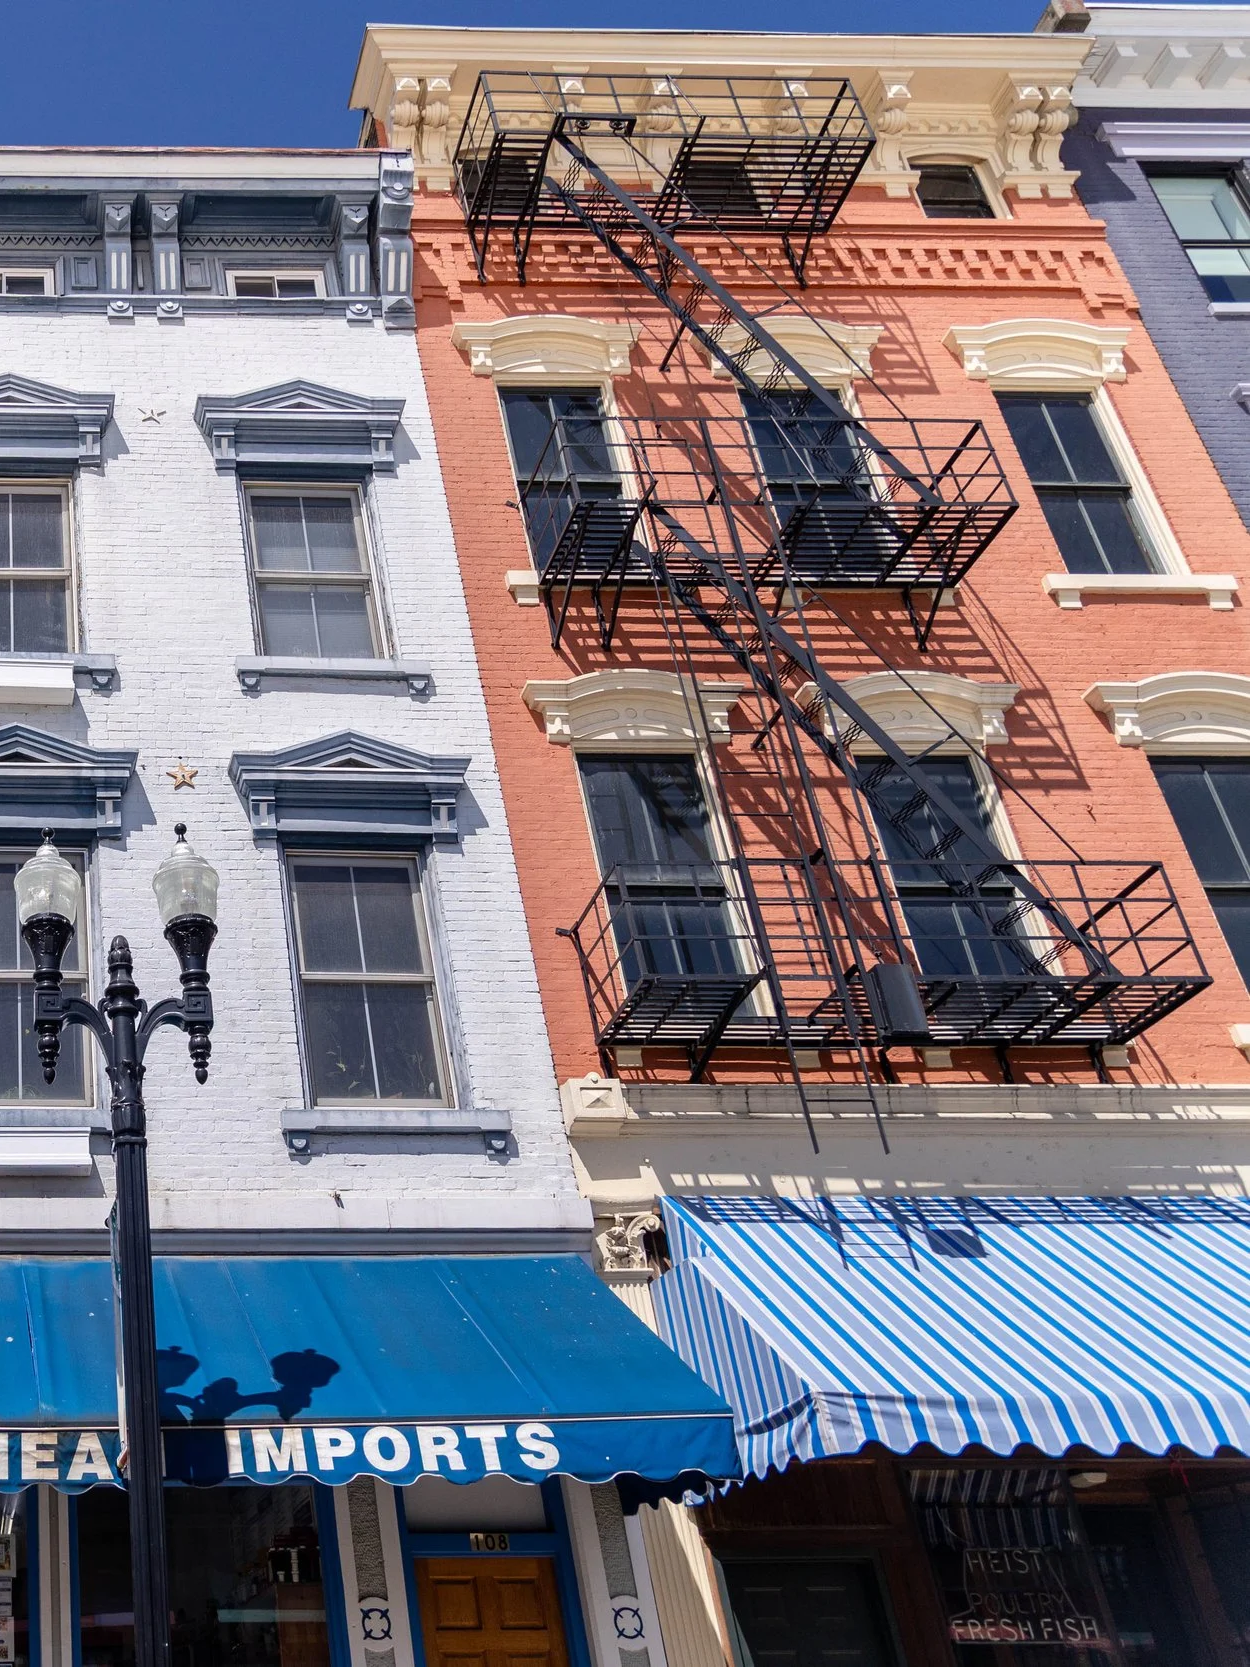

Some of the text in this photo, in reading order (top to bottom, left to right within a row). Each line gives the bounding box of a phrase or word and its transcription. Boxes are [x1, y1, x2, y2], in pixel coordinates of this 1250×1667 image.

[225, 1422, 560, 1475] IMPORTS
[474, 1534, 508, 1550] 108
[965, 1550, 1043, 1574] HEIST
[968, 1592, 1066, 1615] POULTRY
[951, 1618, 1100, 1642] FRESH FISH
